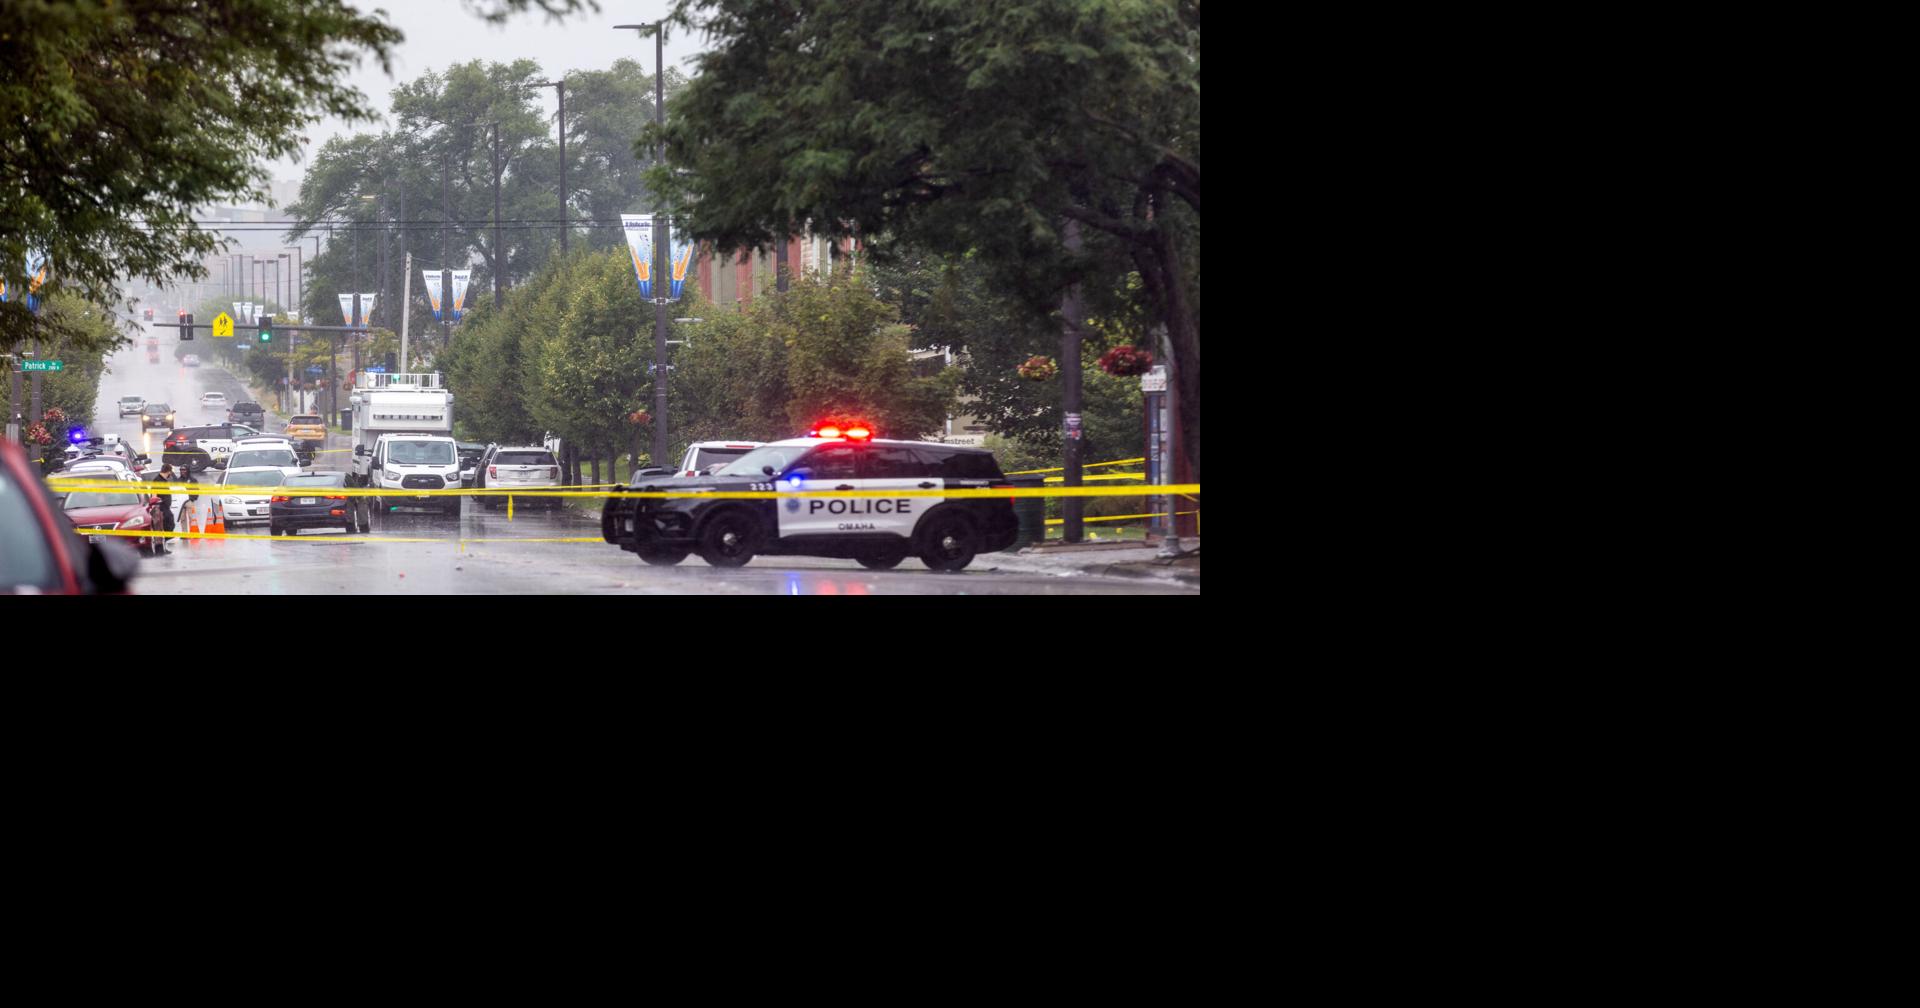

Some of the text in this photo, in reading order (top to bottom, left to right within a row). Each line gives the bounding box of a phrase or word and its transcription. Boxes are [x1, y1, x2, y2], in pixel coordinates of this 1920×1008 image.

[24, 361, 46, 370] Patrick
[809, 499, 912, 514] POLICE
[838, 523, 876, 531] OMAHA
